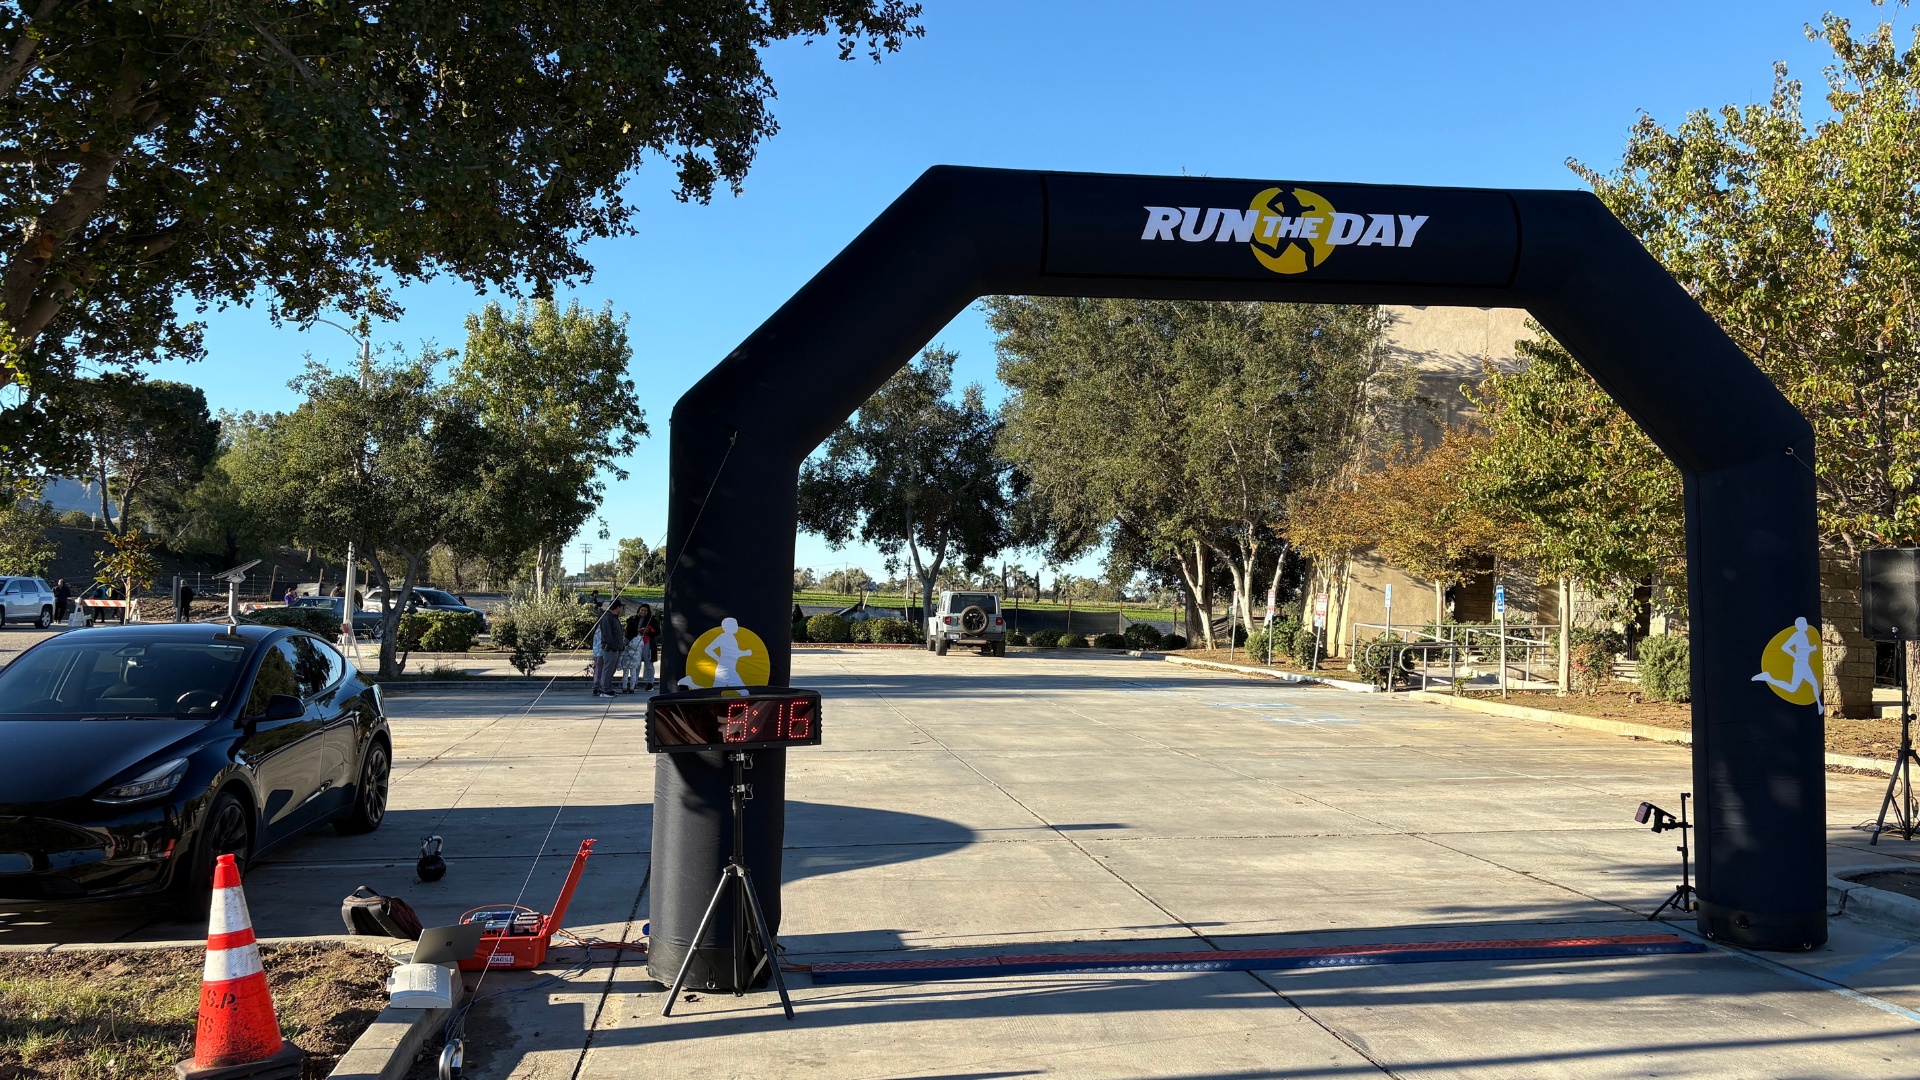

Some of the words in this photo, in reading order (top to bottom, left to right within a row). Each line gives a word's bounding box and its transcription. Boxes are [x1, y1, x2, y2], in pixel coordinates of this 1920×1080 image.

[1141, 206, 1260, 243] RUN
[1262, 216, 1324, 239] THE
[1325, 212, 1430, 248] DAY
[726, 701, 809, 742] 8:16
